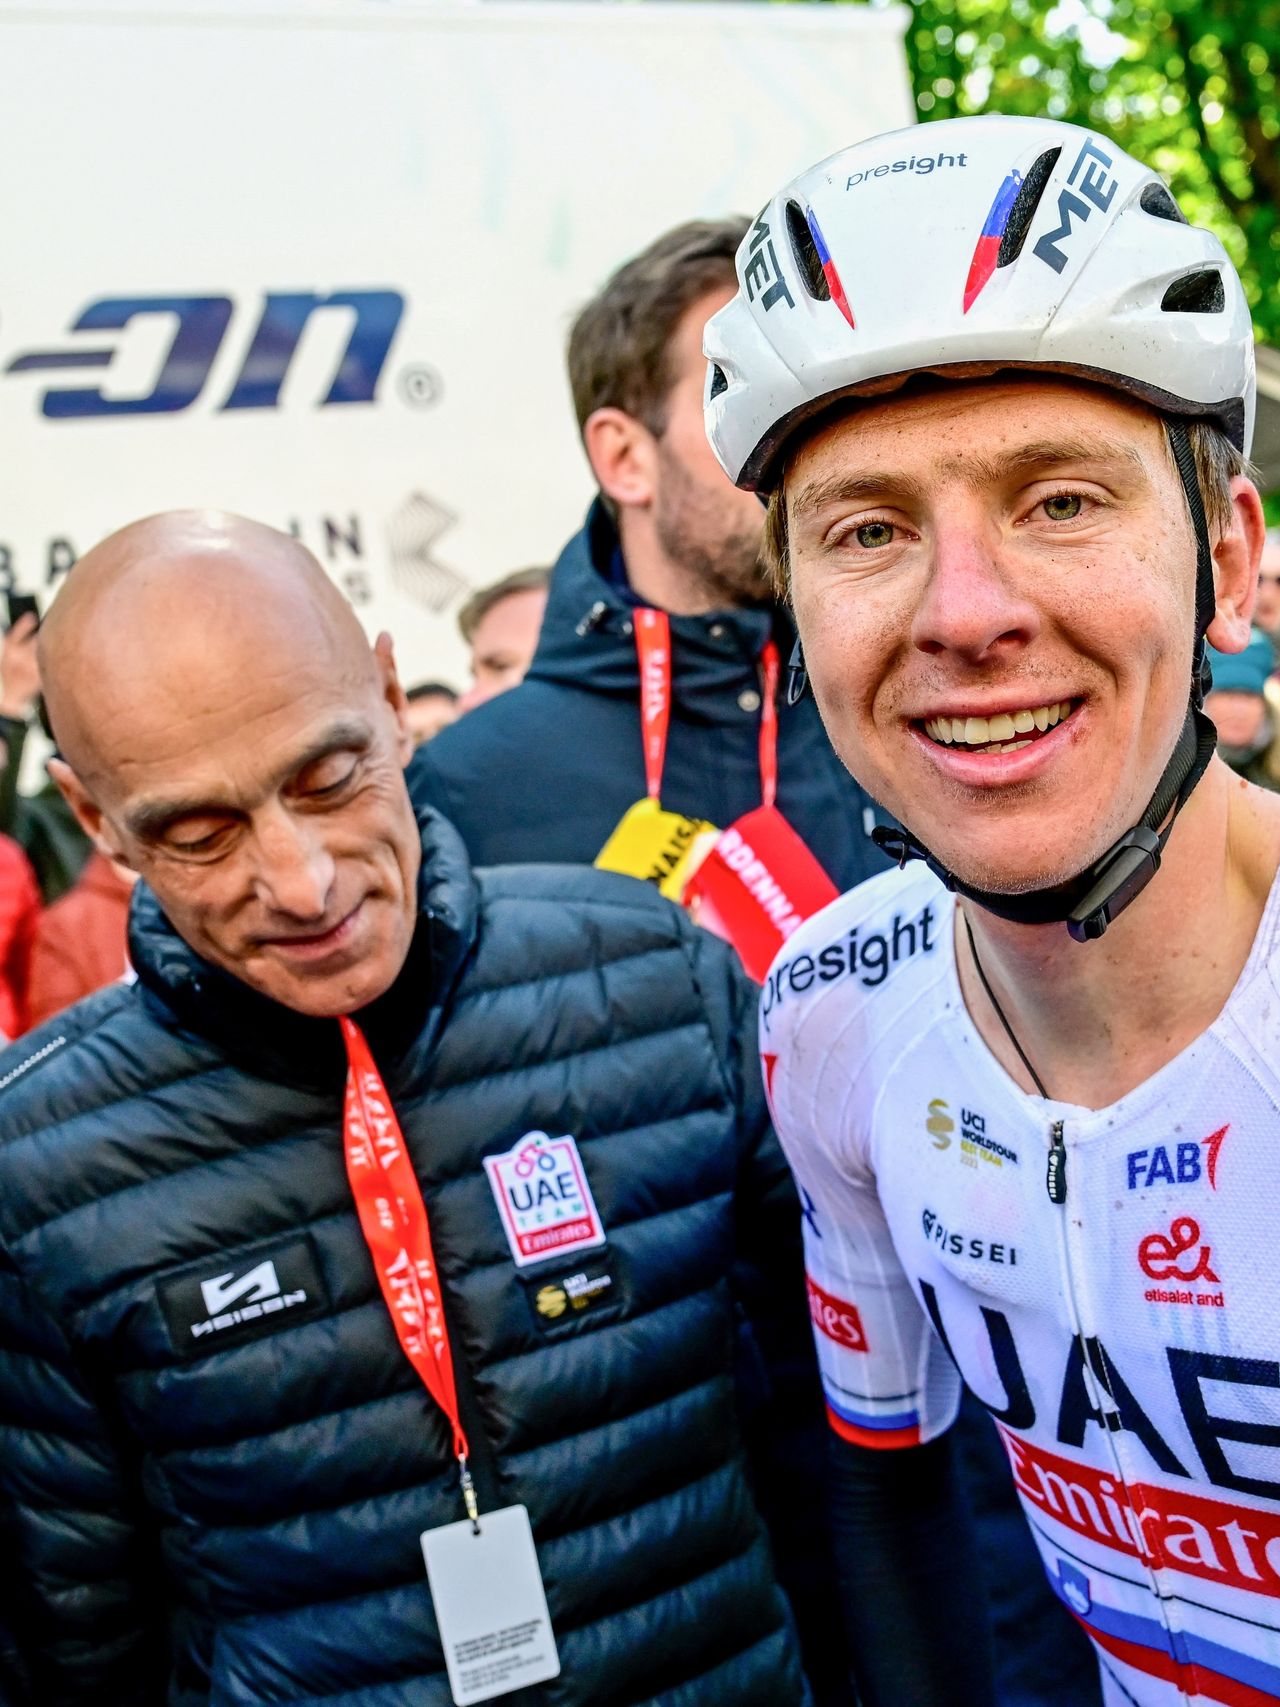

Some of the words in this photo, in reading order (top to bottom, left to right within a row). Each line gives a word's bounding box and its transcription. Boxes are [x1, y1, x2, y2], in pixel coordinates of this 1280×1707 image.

[845, 152, 968, 191] presight
[1032, 137, 1119, 275] MET
[763, 907, 934, 1033] presight
[961, 1108, 986, 1133] UCI
[510, 1171, 579, 1211] UAE
[518, 1202, 583, 1228] TEAM
[935, 1223, 1017, 1266] PISSEI
[1144, 1288, 1193, 1305] etisalat
[1196, 1291, 1225, 1307] and
